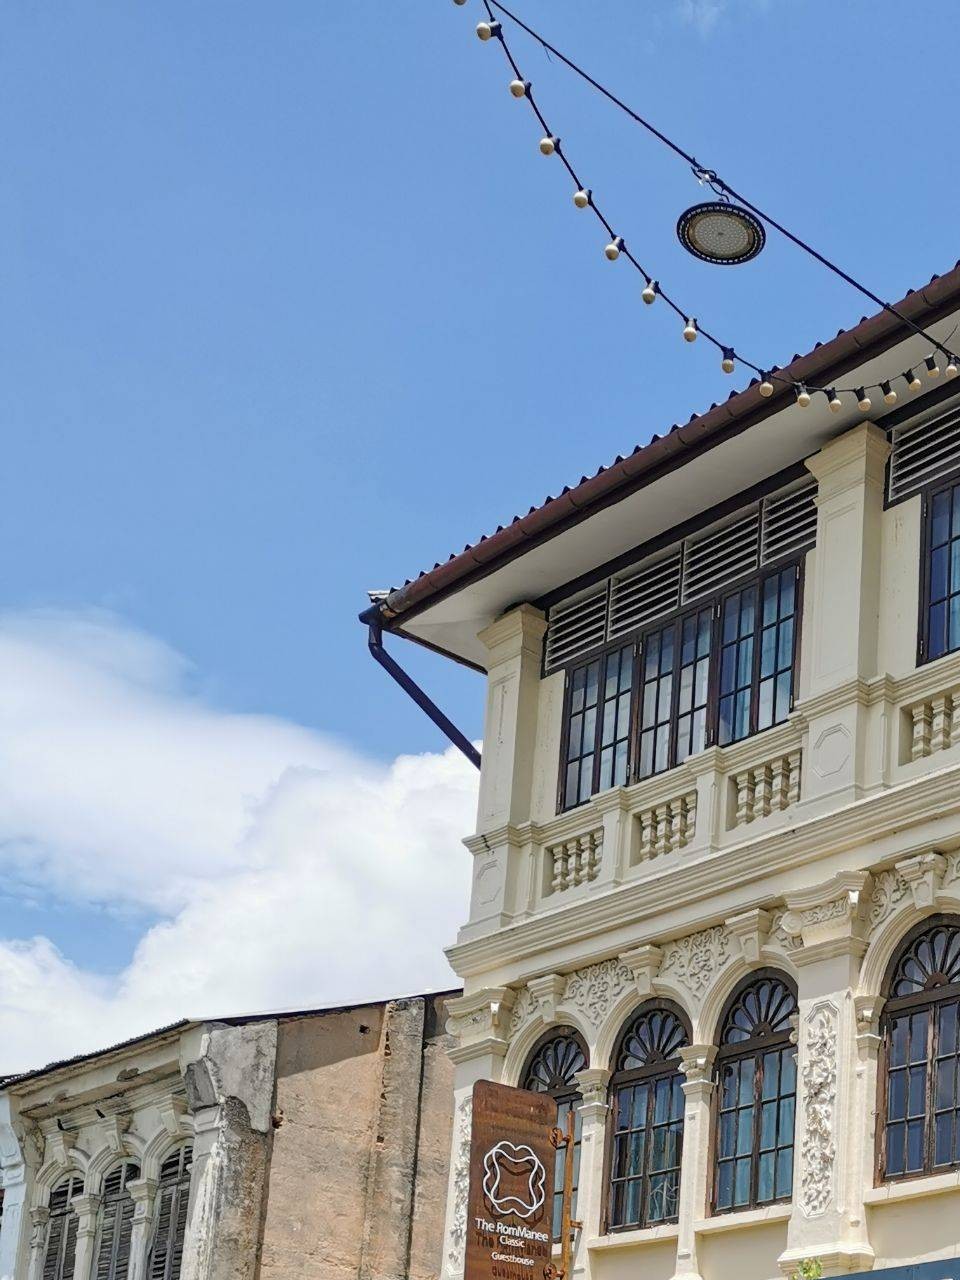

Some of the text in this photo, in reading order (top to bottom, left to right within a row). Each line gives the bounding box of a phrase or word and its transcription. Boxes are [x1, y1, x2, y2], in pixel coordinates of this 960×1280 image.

[475, 1217, 549, 1242] The RomManee
[499, 1235, 525, 1248] Classic
[491, 1251, 535, 1266] Guesthouse
